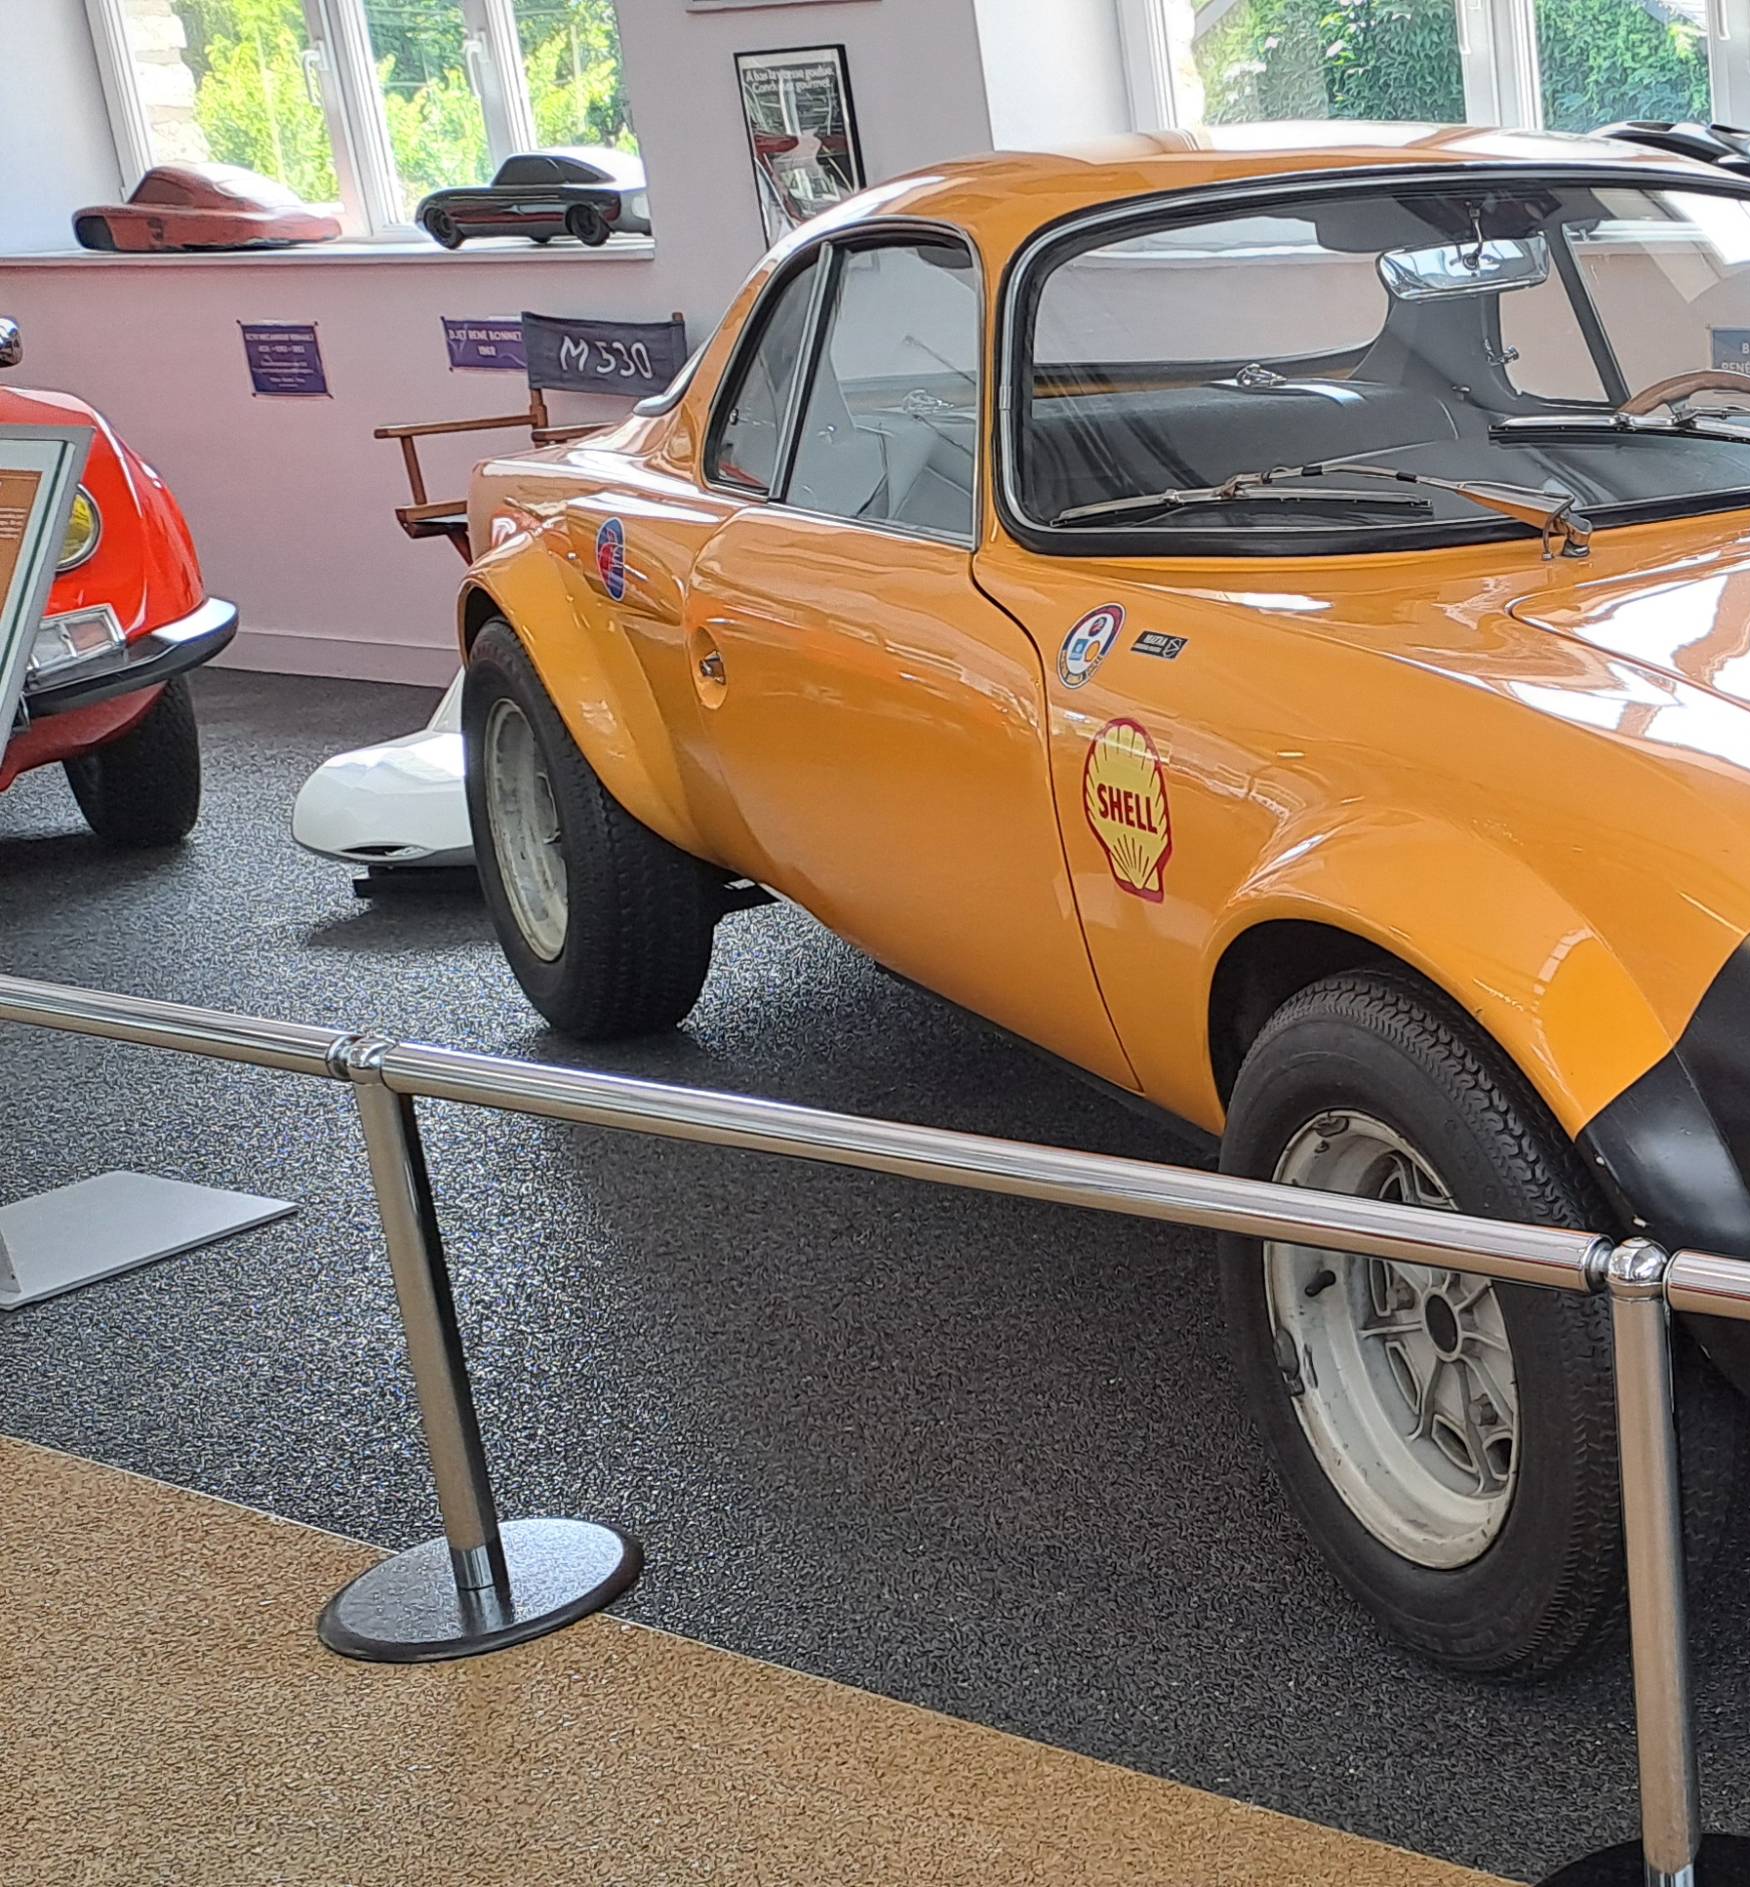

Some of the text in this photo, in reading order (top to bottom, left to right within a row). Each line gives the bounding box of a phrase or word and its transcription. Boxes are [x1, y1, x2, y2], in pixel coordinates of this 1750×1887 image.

[560, 335, 653, 379] M 530
[1097, 782, 1158, 835] SHELL
